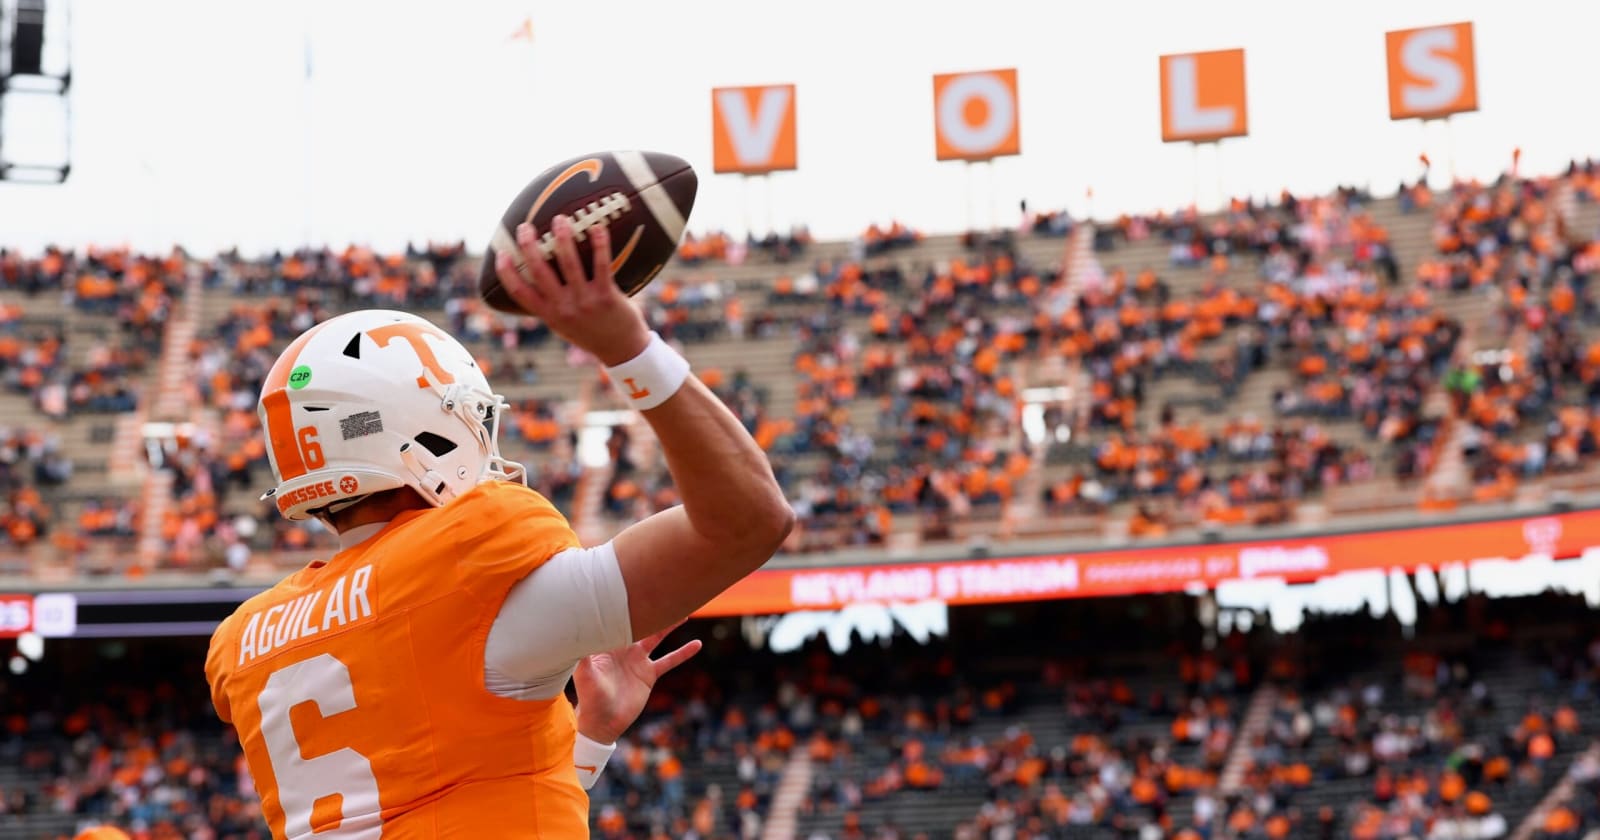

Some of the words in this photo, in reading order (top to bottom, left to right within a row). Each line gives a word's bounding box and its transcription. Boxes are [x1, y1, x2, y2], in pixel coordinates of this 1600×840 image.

[716, 86, 793, 165] V
[939, 73, 1016, 154] O
[1168, 55, 1236, 136] L
[1399, 27, 1466, 112] S
[290, 371, 310, 382] C2P
[297, 425, 326, 471] 6
[238, 564, 373, 666] AGUILAR
[257, 652, 384, 840] 6
